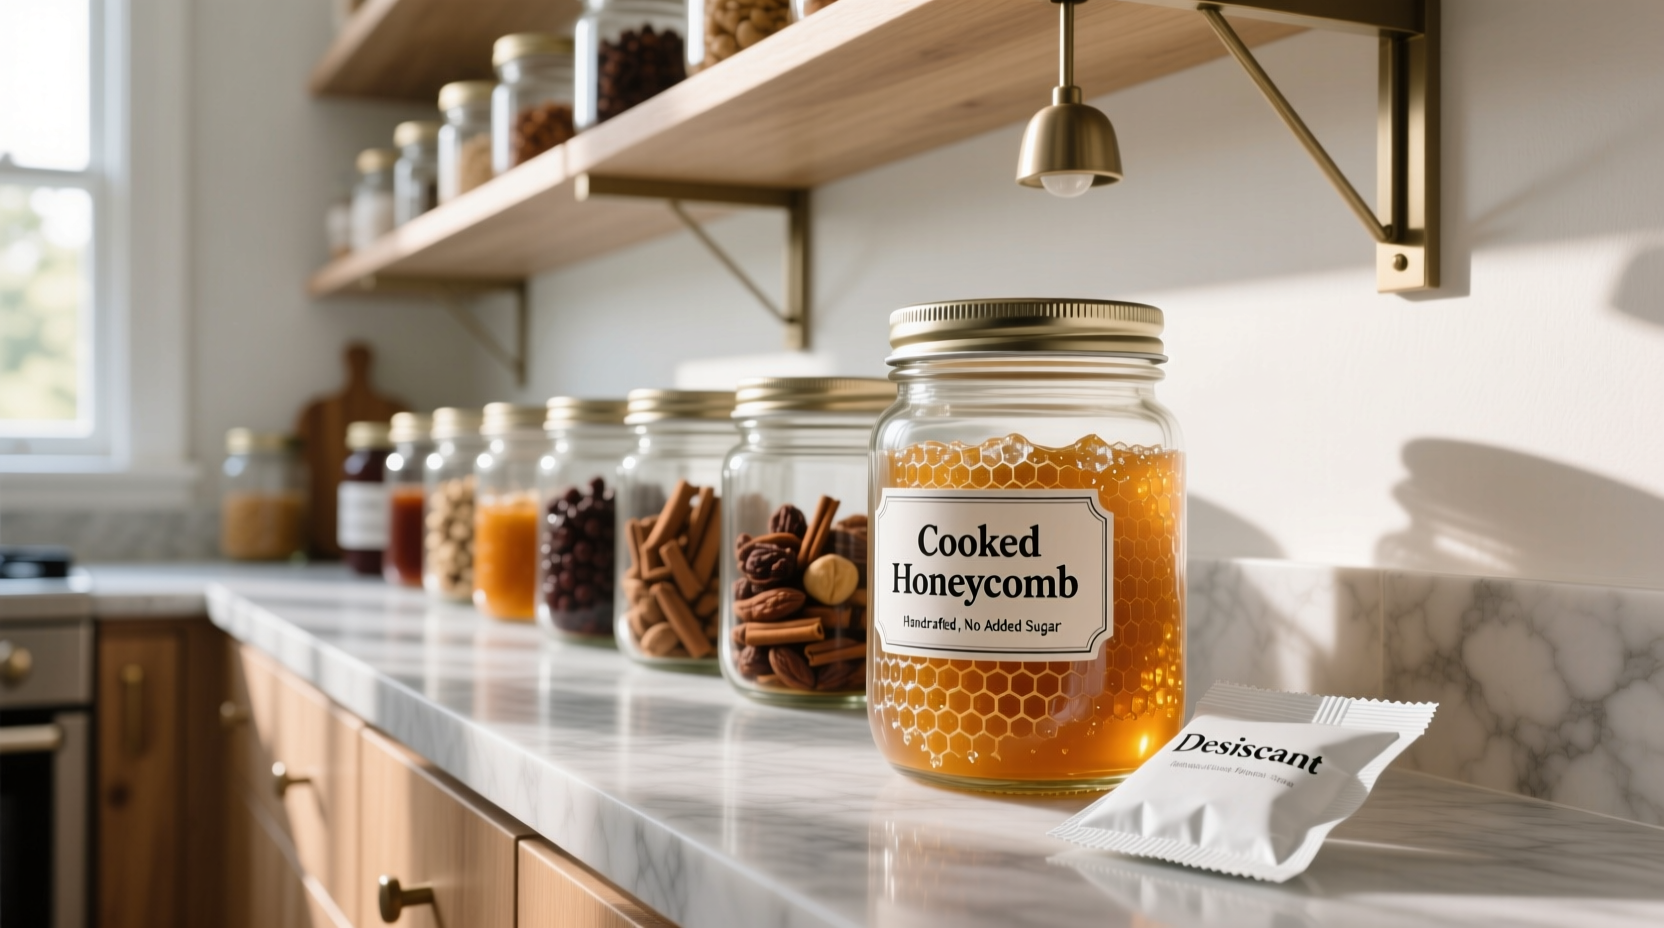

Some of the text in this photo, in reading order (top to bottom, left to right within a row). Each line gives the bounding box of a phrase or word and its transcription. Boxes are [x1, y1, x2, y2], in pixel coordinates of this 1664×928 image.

[918, 523, 1042, 557] Cooked
[892, 562, 1079, 607] Honeycomb
[964, 617, 981, 632] No
[983, 618, 1022, 632] Added
[1025, 620, 1062, 637] Sugar
[1172, 733, 1323, 775] Desiscant
